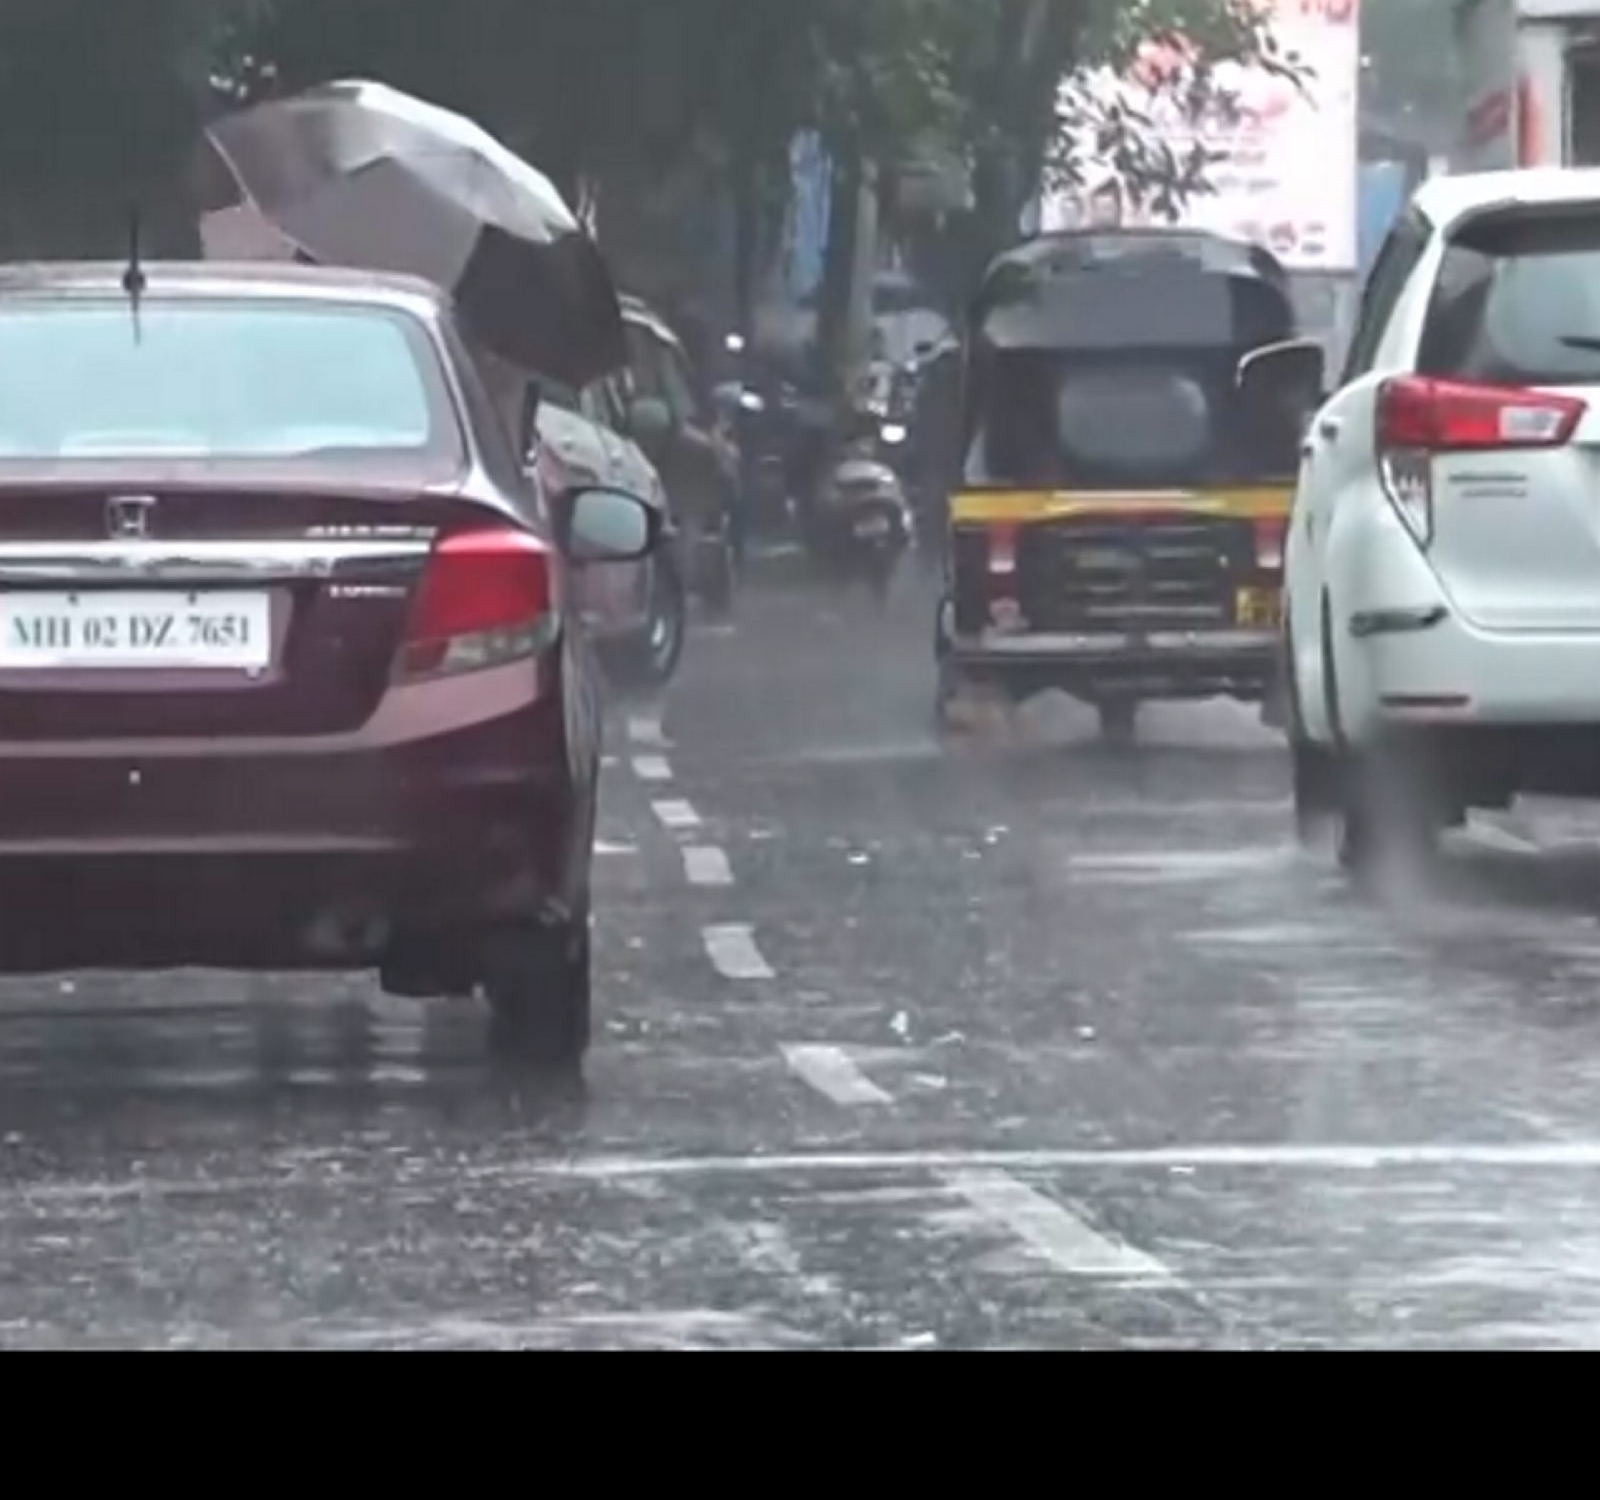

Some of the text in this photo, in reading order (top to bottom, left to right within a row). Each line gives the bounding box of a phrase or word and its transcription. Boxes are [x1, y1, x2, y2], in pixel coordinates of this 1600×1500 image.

[13, 615, 71, 648] MH
[83, 616, 117, 648] 02
[129, 616, 174, 648] DZ
